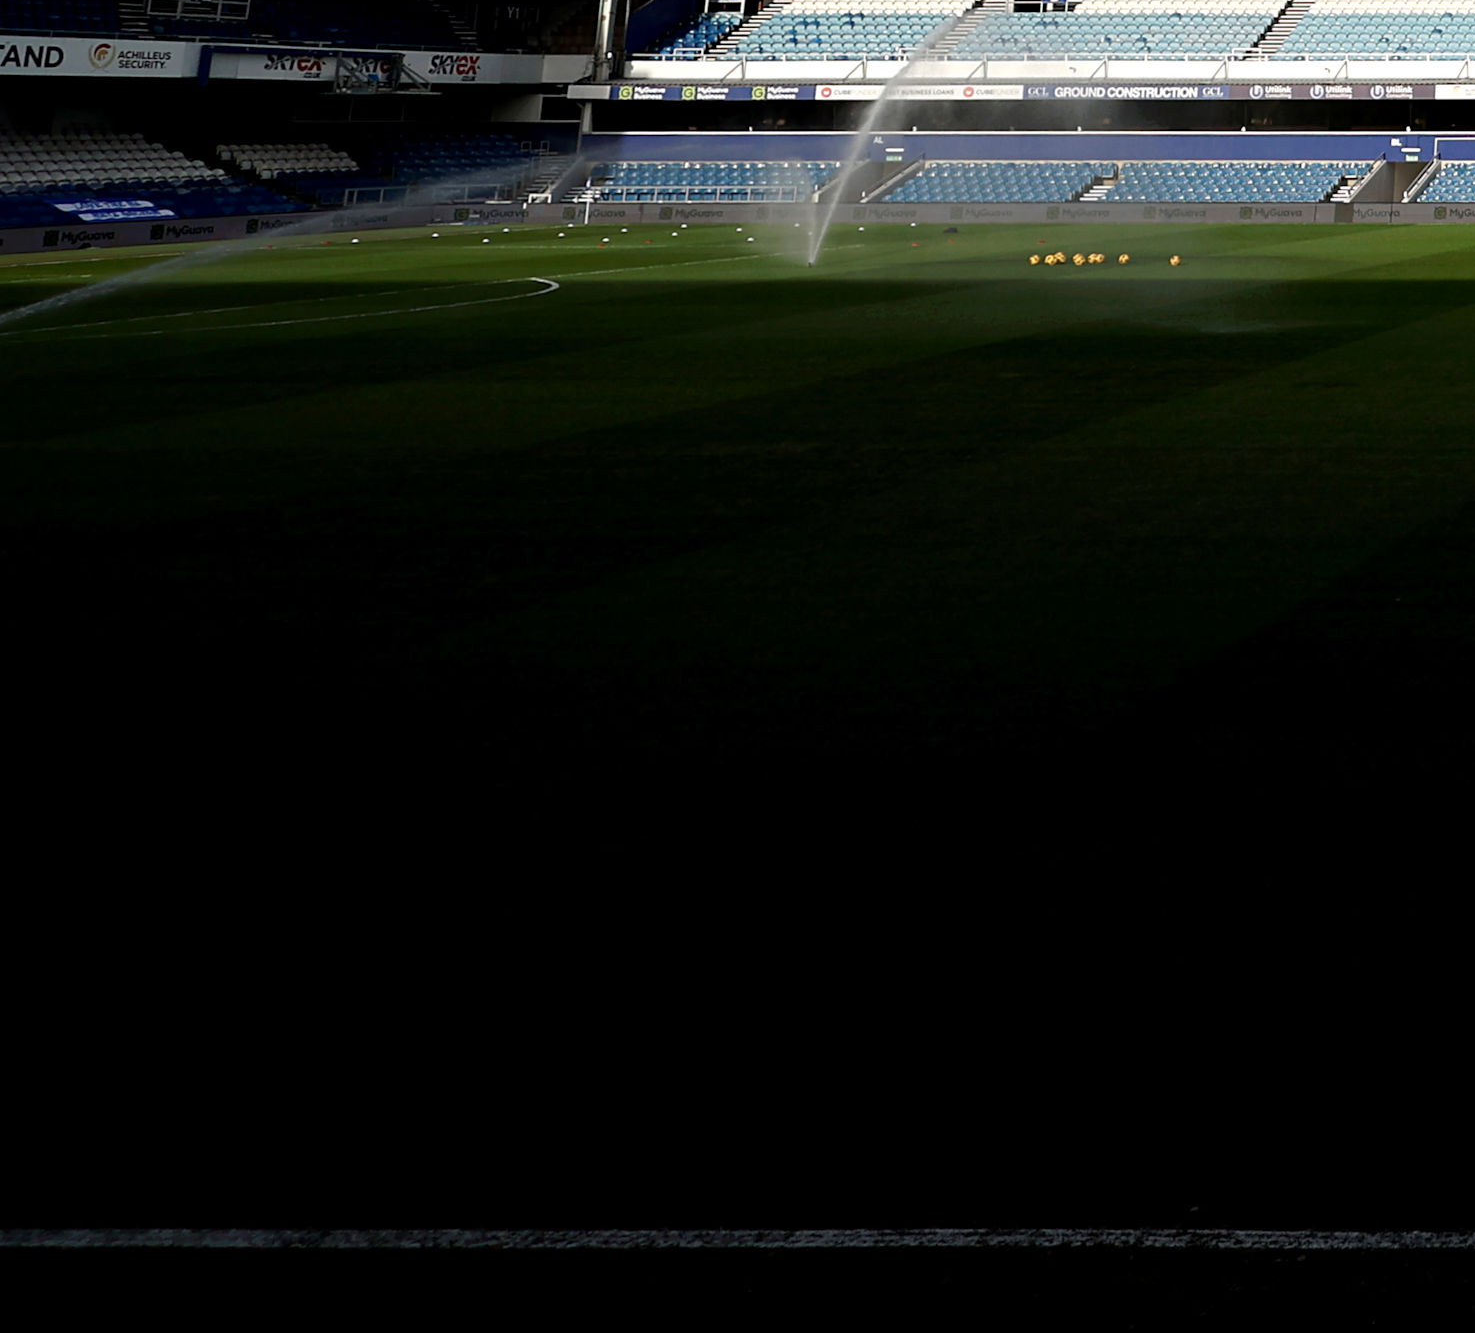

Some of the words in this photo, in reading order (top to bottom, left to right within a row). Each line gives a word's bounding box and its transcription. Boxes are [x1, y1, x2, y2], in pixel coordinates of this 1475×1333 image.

[507, 6, 520, 20] Y1
[117, 50, 172, 61] ACHILLEUS
[118, 59, 166, 69] SECURITY
[429, 55, 481, 75] SKYEX
[1054, 86, 1106, 98] GROUND
[1107, 86, 1199, 98] CONSTRUCTION
[675, 207, 724, 219] MyGuava
[1255, 208, 1303, 219] MyGuava
[166, 224, 214, 238] MyGuava
[61, 231, 115, 245] MyGuava
